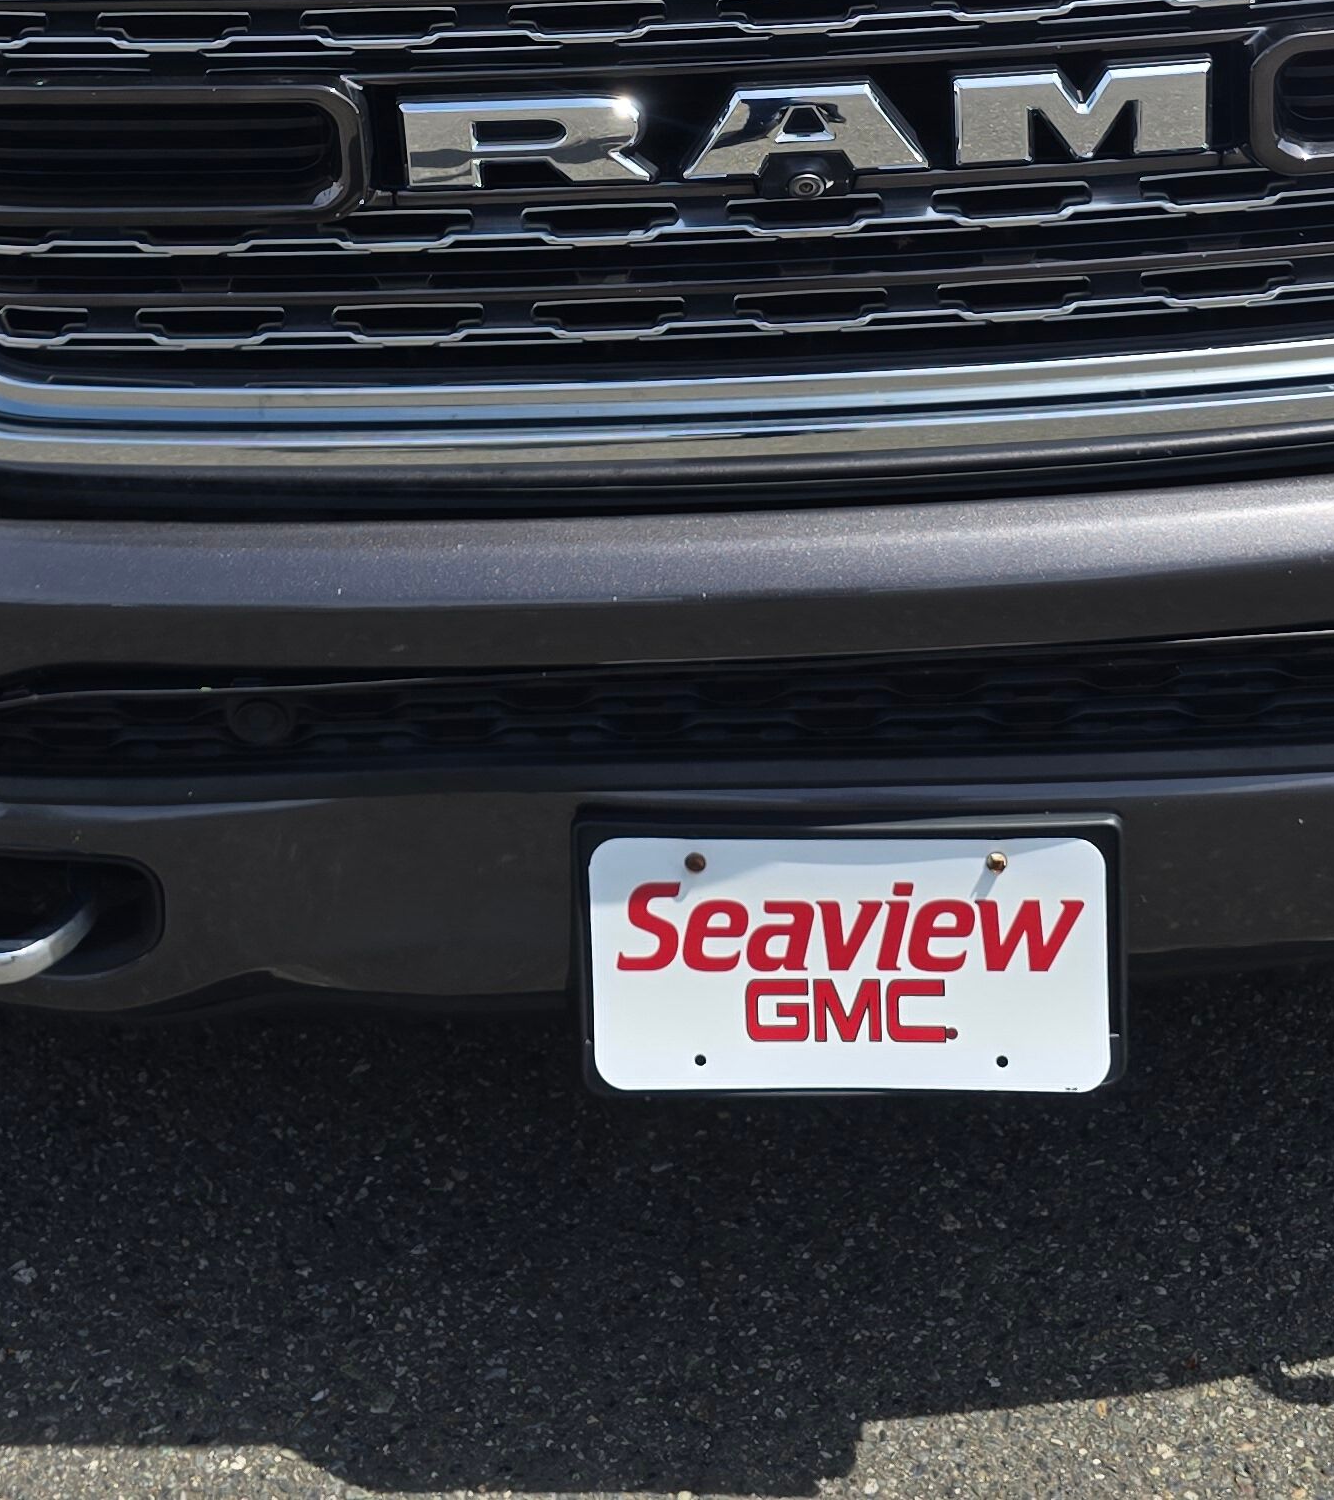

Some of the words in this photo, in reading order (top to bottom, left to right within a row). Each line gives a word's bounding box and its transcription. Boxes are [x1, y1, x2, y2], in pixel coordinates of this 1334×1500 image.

[397, 54, 1212, 188] RAM
[616, 881, 1085, 972] Seaview
[745, 978, 948, 1043] GMC
